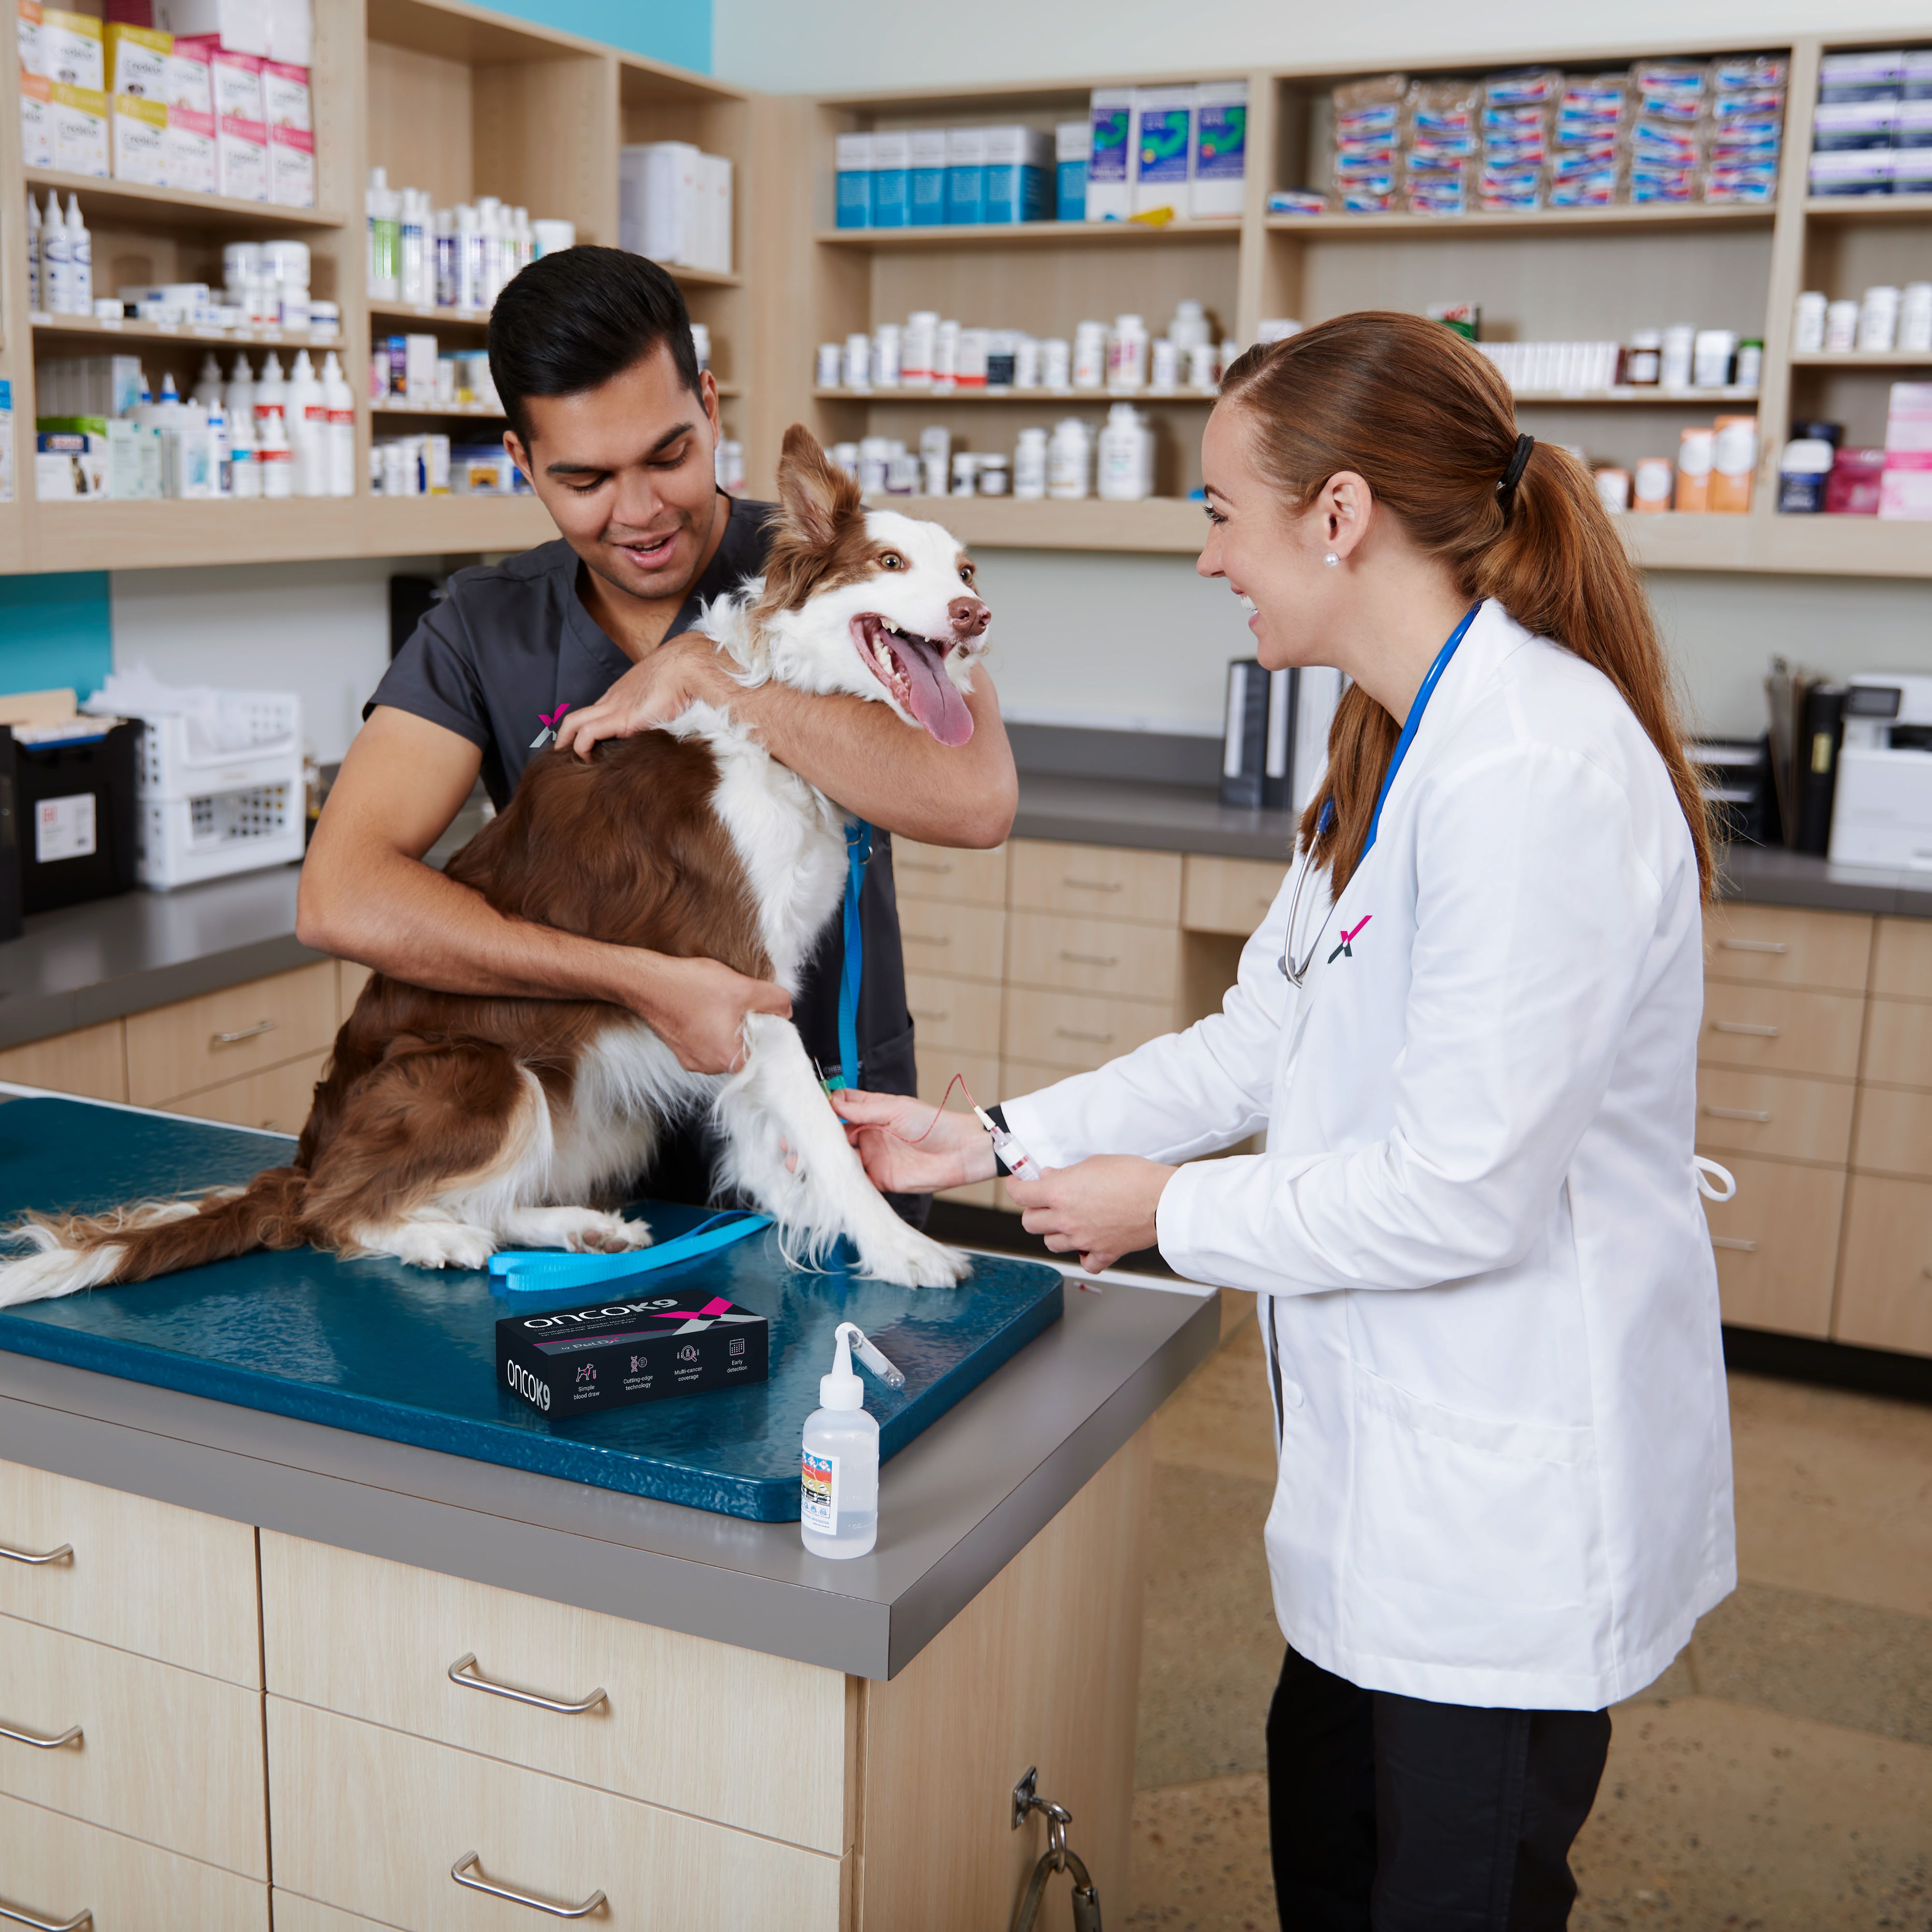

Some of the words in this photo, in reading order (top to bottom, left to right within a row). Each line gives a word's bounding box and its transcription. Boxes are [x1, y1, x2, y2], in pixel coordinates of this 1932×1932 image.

[674, 1366, 703, 1376] Multi-cancer
[623, 1375, 653, 1384] Cutting-edge
[625, 1382, 652, 1391] technology
